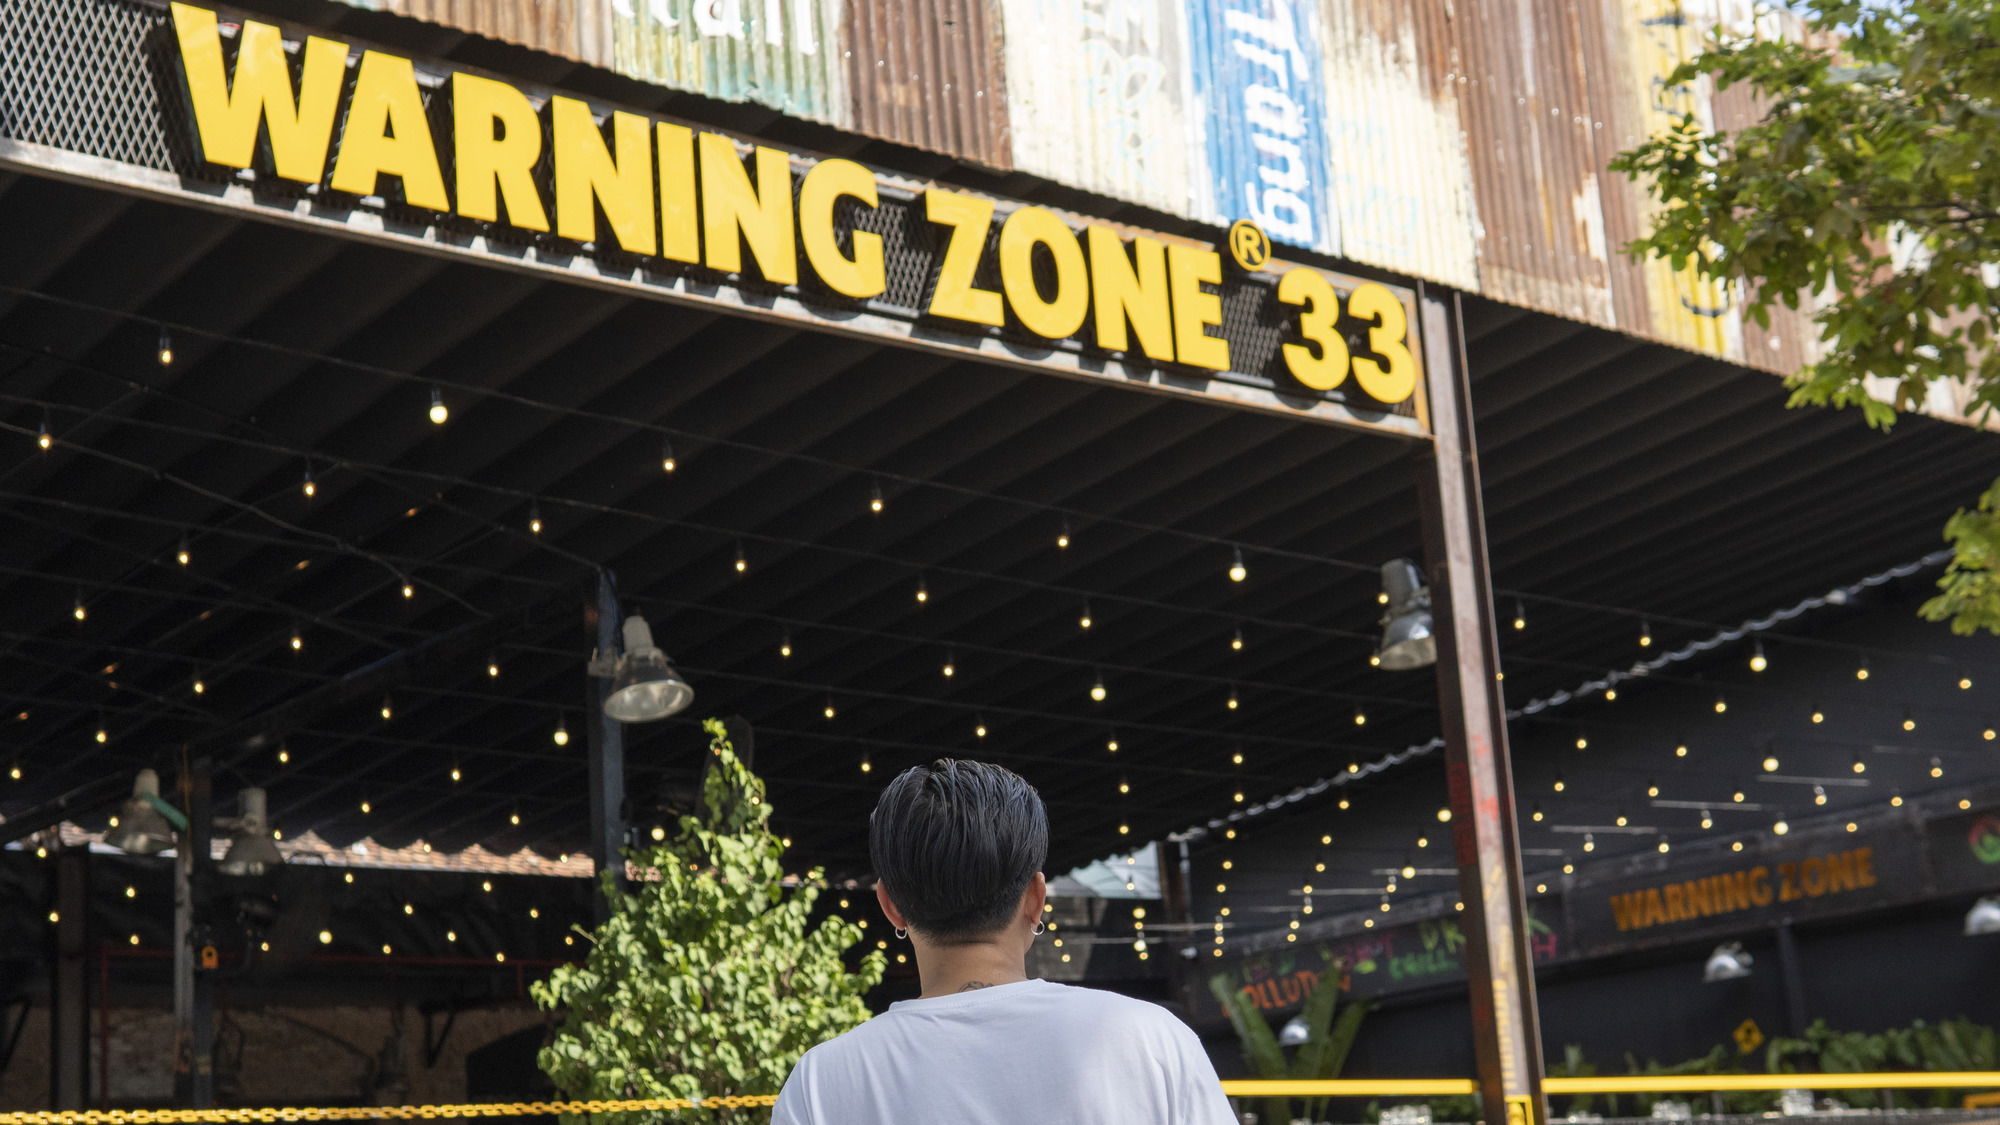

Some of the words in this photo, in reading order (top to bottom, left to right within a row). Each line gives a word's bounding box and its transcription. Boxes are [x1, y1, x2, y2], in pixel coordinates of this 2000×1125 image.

[171, 2, 887, 299] WARNING
[926, 188, 1231, 371] ZONE
[1278, 268, 1416, 403] 33
[1610, 866, 1773, 932] WARNING
[1778, 847, 1877, 903] ZONE
